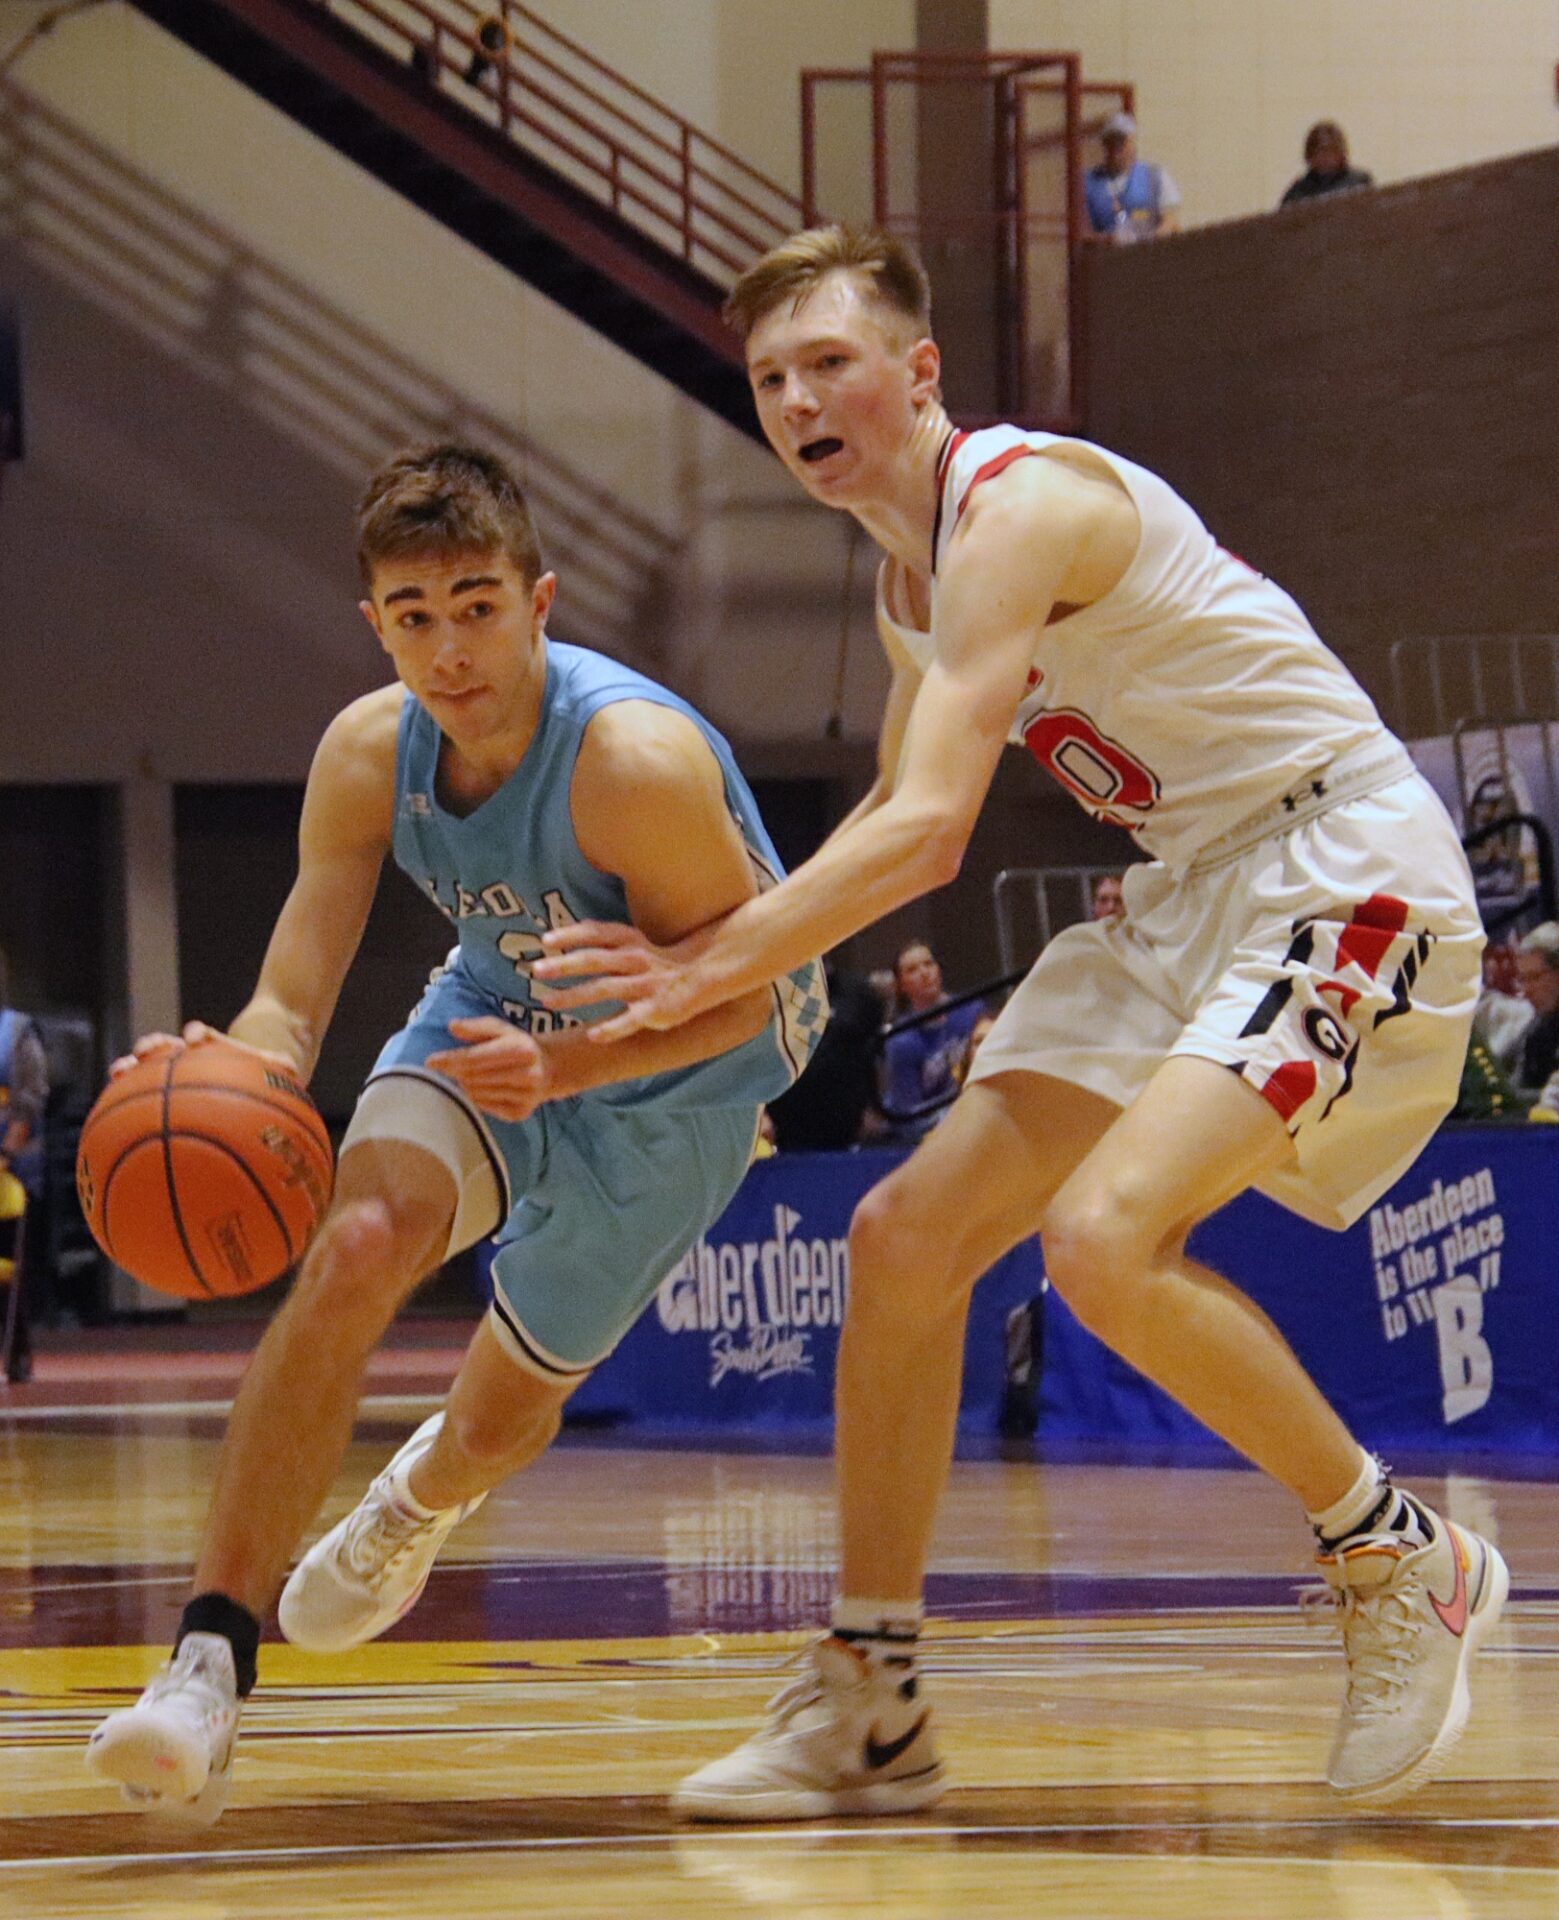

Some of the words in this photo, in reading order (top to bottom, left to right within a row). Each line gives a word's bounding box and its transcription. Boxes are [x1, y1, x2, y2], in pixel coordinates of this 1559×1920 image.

[1301, 1005, 1349, 1063] G
[1370, 1167, 1497, 1259] Aberdeen
[1374, 1261, 1399, 1302] is
[1401, 1245, 1438, 1290] the
[1442, 1213, 1505, 1279] place
[1382, 1302, 1408, 1342] to
